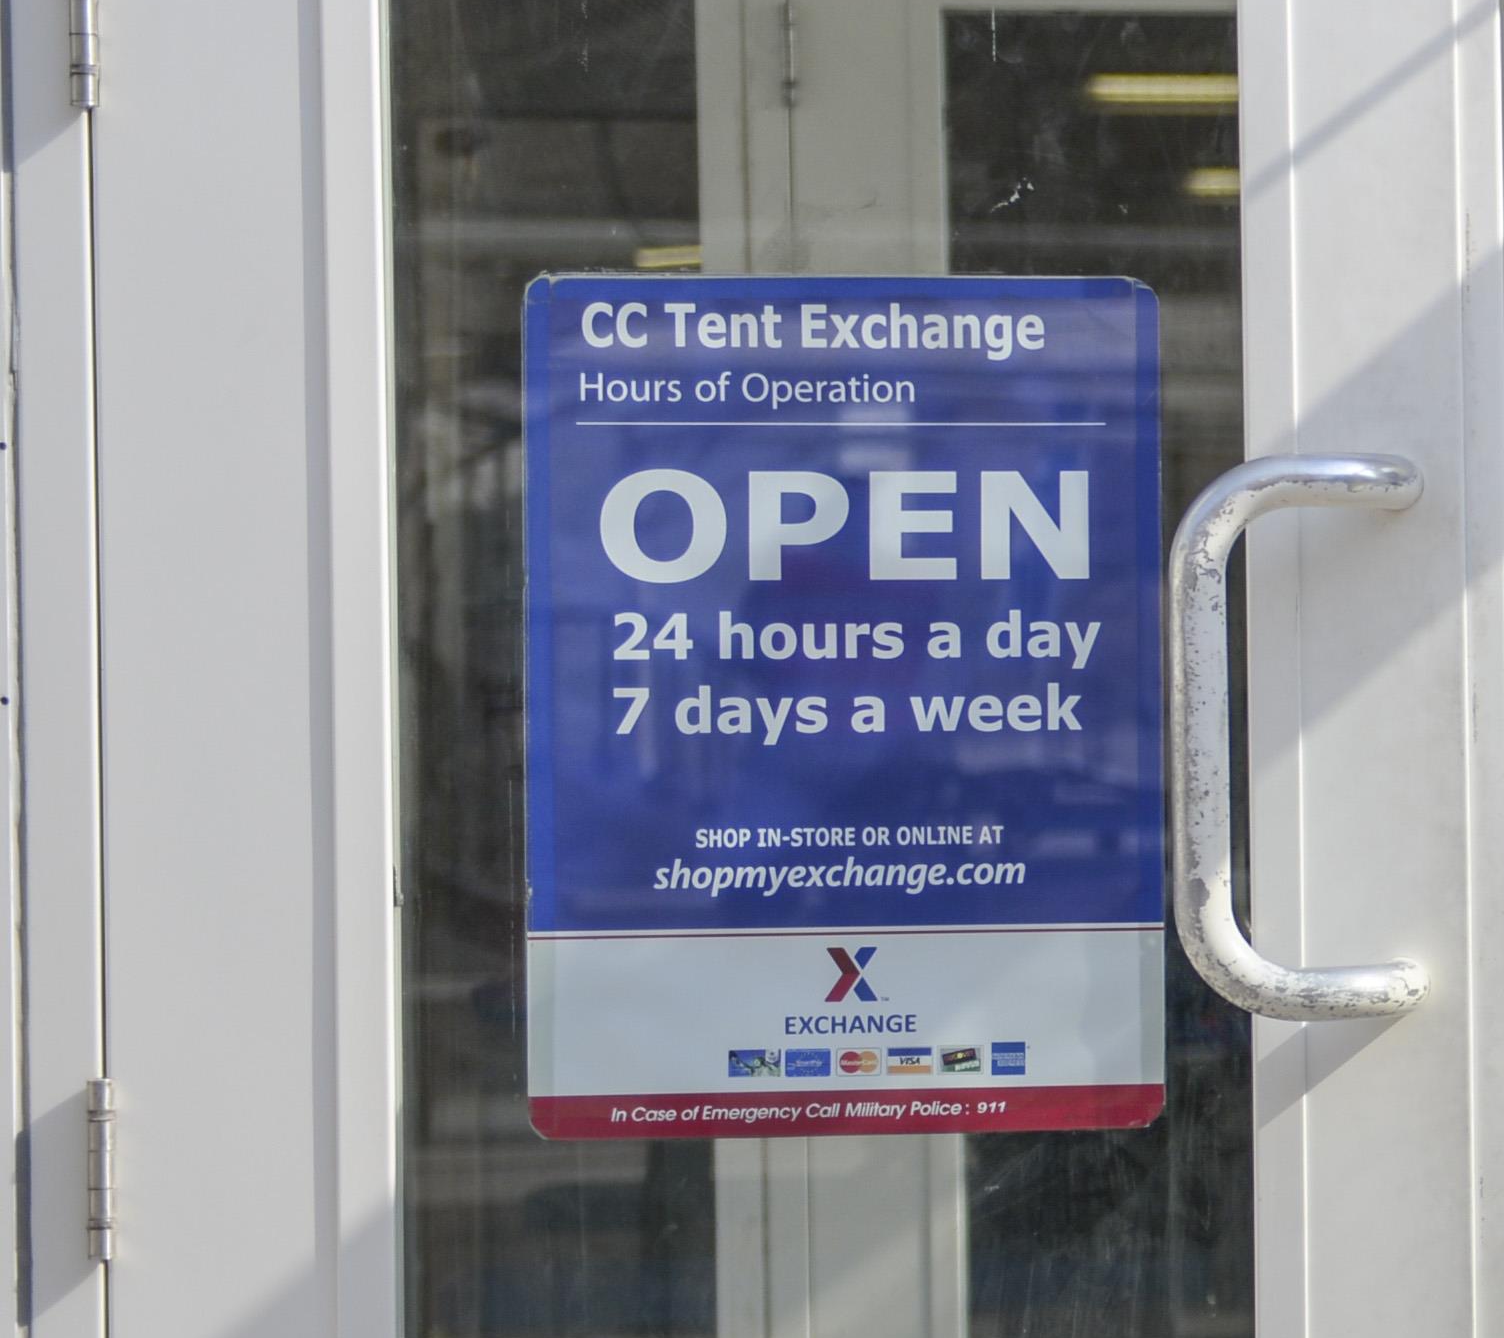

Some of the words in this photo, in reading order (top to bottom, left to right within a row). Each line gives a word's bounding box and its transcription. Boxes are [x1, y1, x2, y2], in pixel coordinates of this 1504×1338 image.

[581, 302, 648, 349] CC
[664, 303, 782, 349] Tent
[800, 303, 1046, 361] Exchange
[579, 372, 682, 403] Hours
[694, 371, 732, 403] of
[741, 372, 916, 410] Operation
[600, 468, 1090, 583] OPEN
[613, 612, 693, 660] 24
[719, 612, 905, 660] hours
[927, 620, 962, 658] a
[986, 610, 1102, 669] day
[613, 687, 651, 734] 7
[674, 685, 828, 745] days
[851, 696, 886, 732] a
[910, 682, 1083, 731] week
[695, 828, 751, 849] SHOP
[757, 827, 856, 848] IN-STORE
[862, 827, 891, 847] OR
[896, 826, 973, 846] ONLINE
[979, 825, 1004, 845] AT
[653, 857, 1026, 898] shopmyexchange.com
[785, 1014, 918, 1035] EXCHANGE
[611, 1107, 627, 1122] In
[631, 1106, 676, 1122] Case
[681, 1106, 699, 1121] of
[702, 1104, 802, 1123] Emergency
[806, 1102, 840, 1118] Call
[844, 1101, 906, 1120] Military
[977, 1101, 1006, 1114] 911
